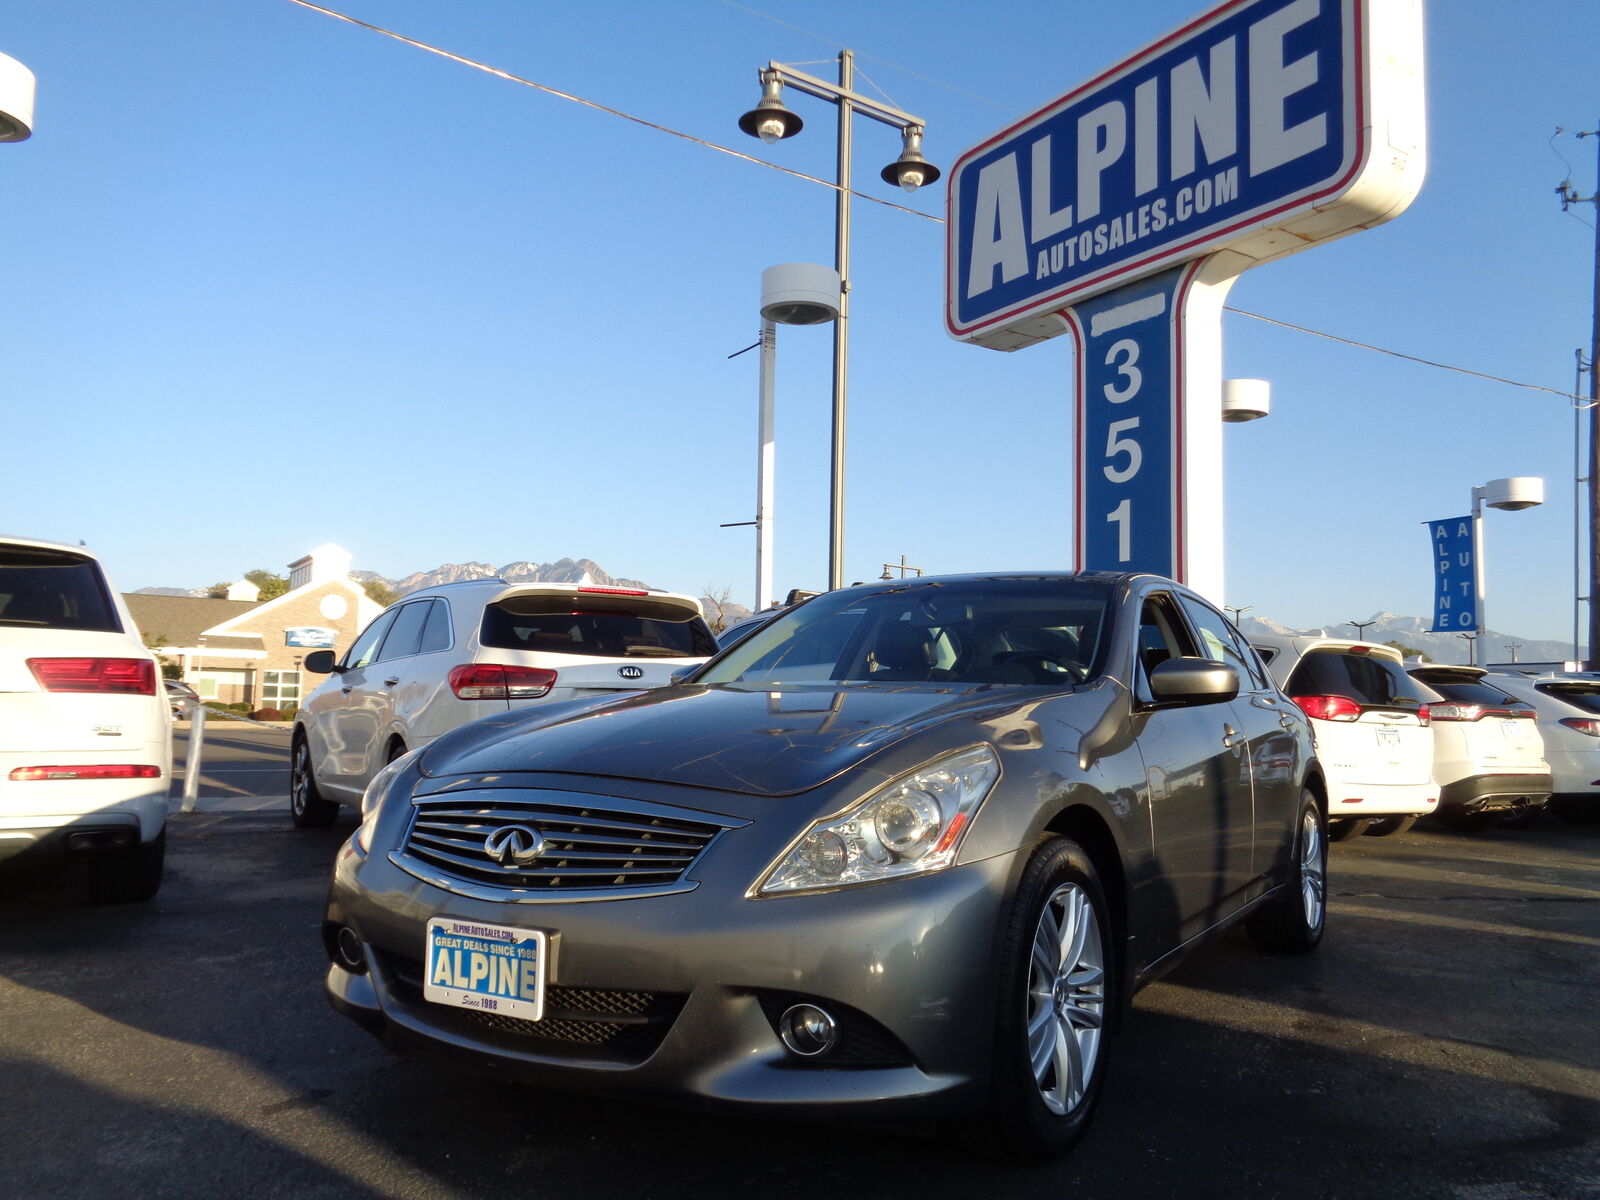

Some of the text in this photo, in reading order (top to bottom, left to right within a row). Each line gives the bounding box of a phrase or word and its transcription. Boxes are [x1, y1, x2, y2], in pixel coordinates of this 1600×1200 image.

[967, 0, 1327, 299] ALPINE
[1036, 166, 1239, 281] AUTOSALES.COM
[1436, 525, 1451, 627] ALPINE
[1457, 522, 1472, 627] AUTO
[622, 668, 640, 676] KIA
[433, 948, 536, 999] ALPINE
[435, 936, 536, 960] GREAT DEALS SINCE 1988
[462, 995, 498, 1010] Since 1988
